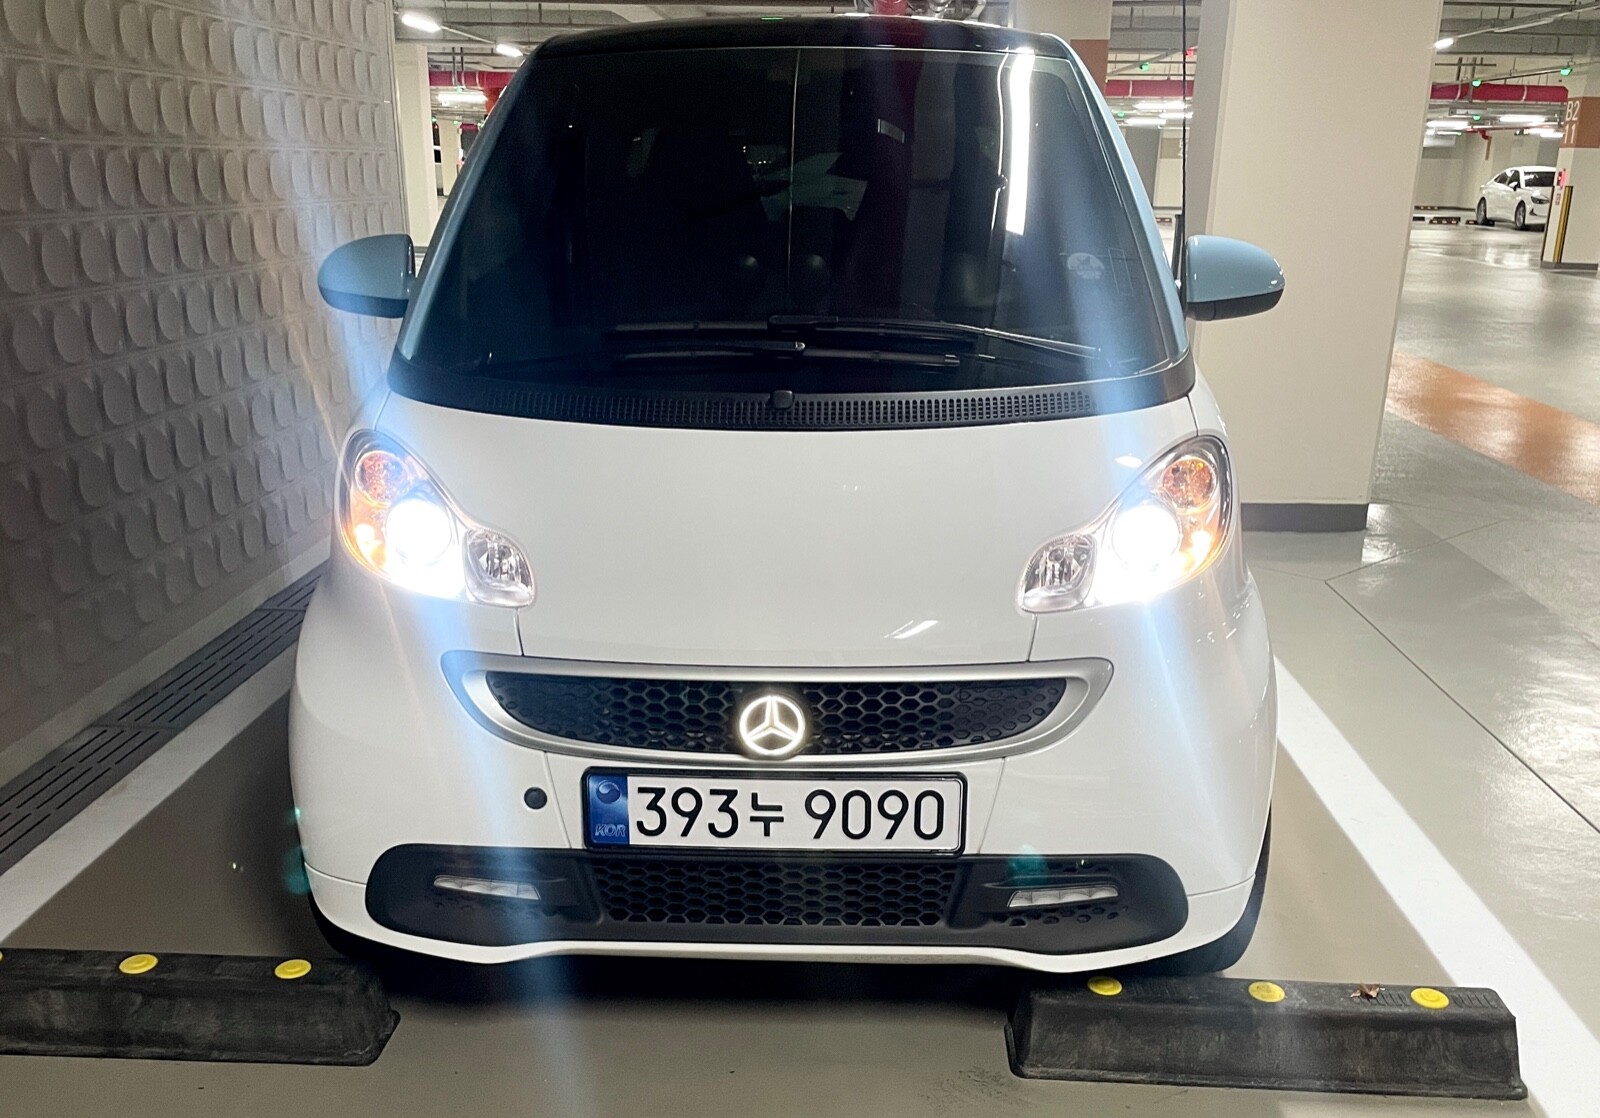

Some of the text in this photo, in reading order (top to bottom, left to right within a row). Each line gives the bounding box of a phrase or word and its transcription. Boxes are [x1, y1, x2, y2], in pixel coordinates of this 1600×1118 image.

[1565, 100, 1580, 121] B2
[1564, 123, 1576, 144] 11
[636, 786, 945, 841] 393누 9090
[595, 823, 626, 838] KOR
